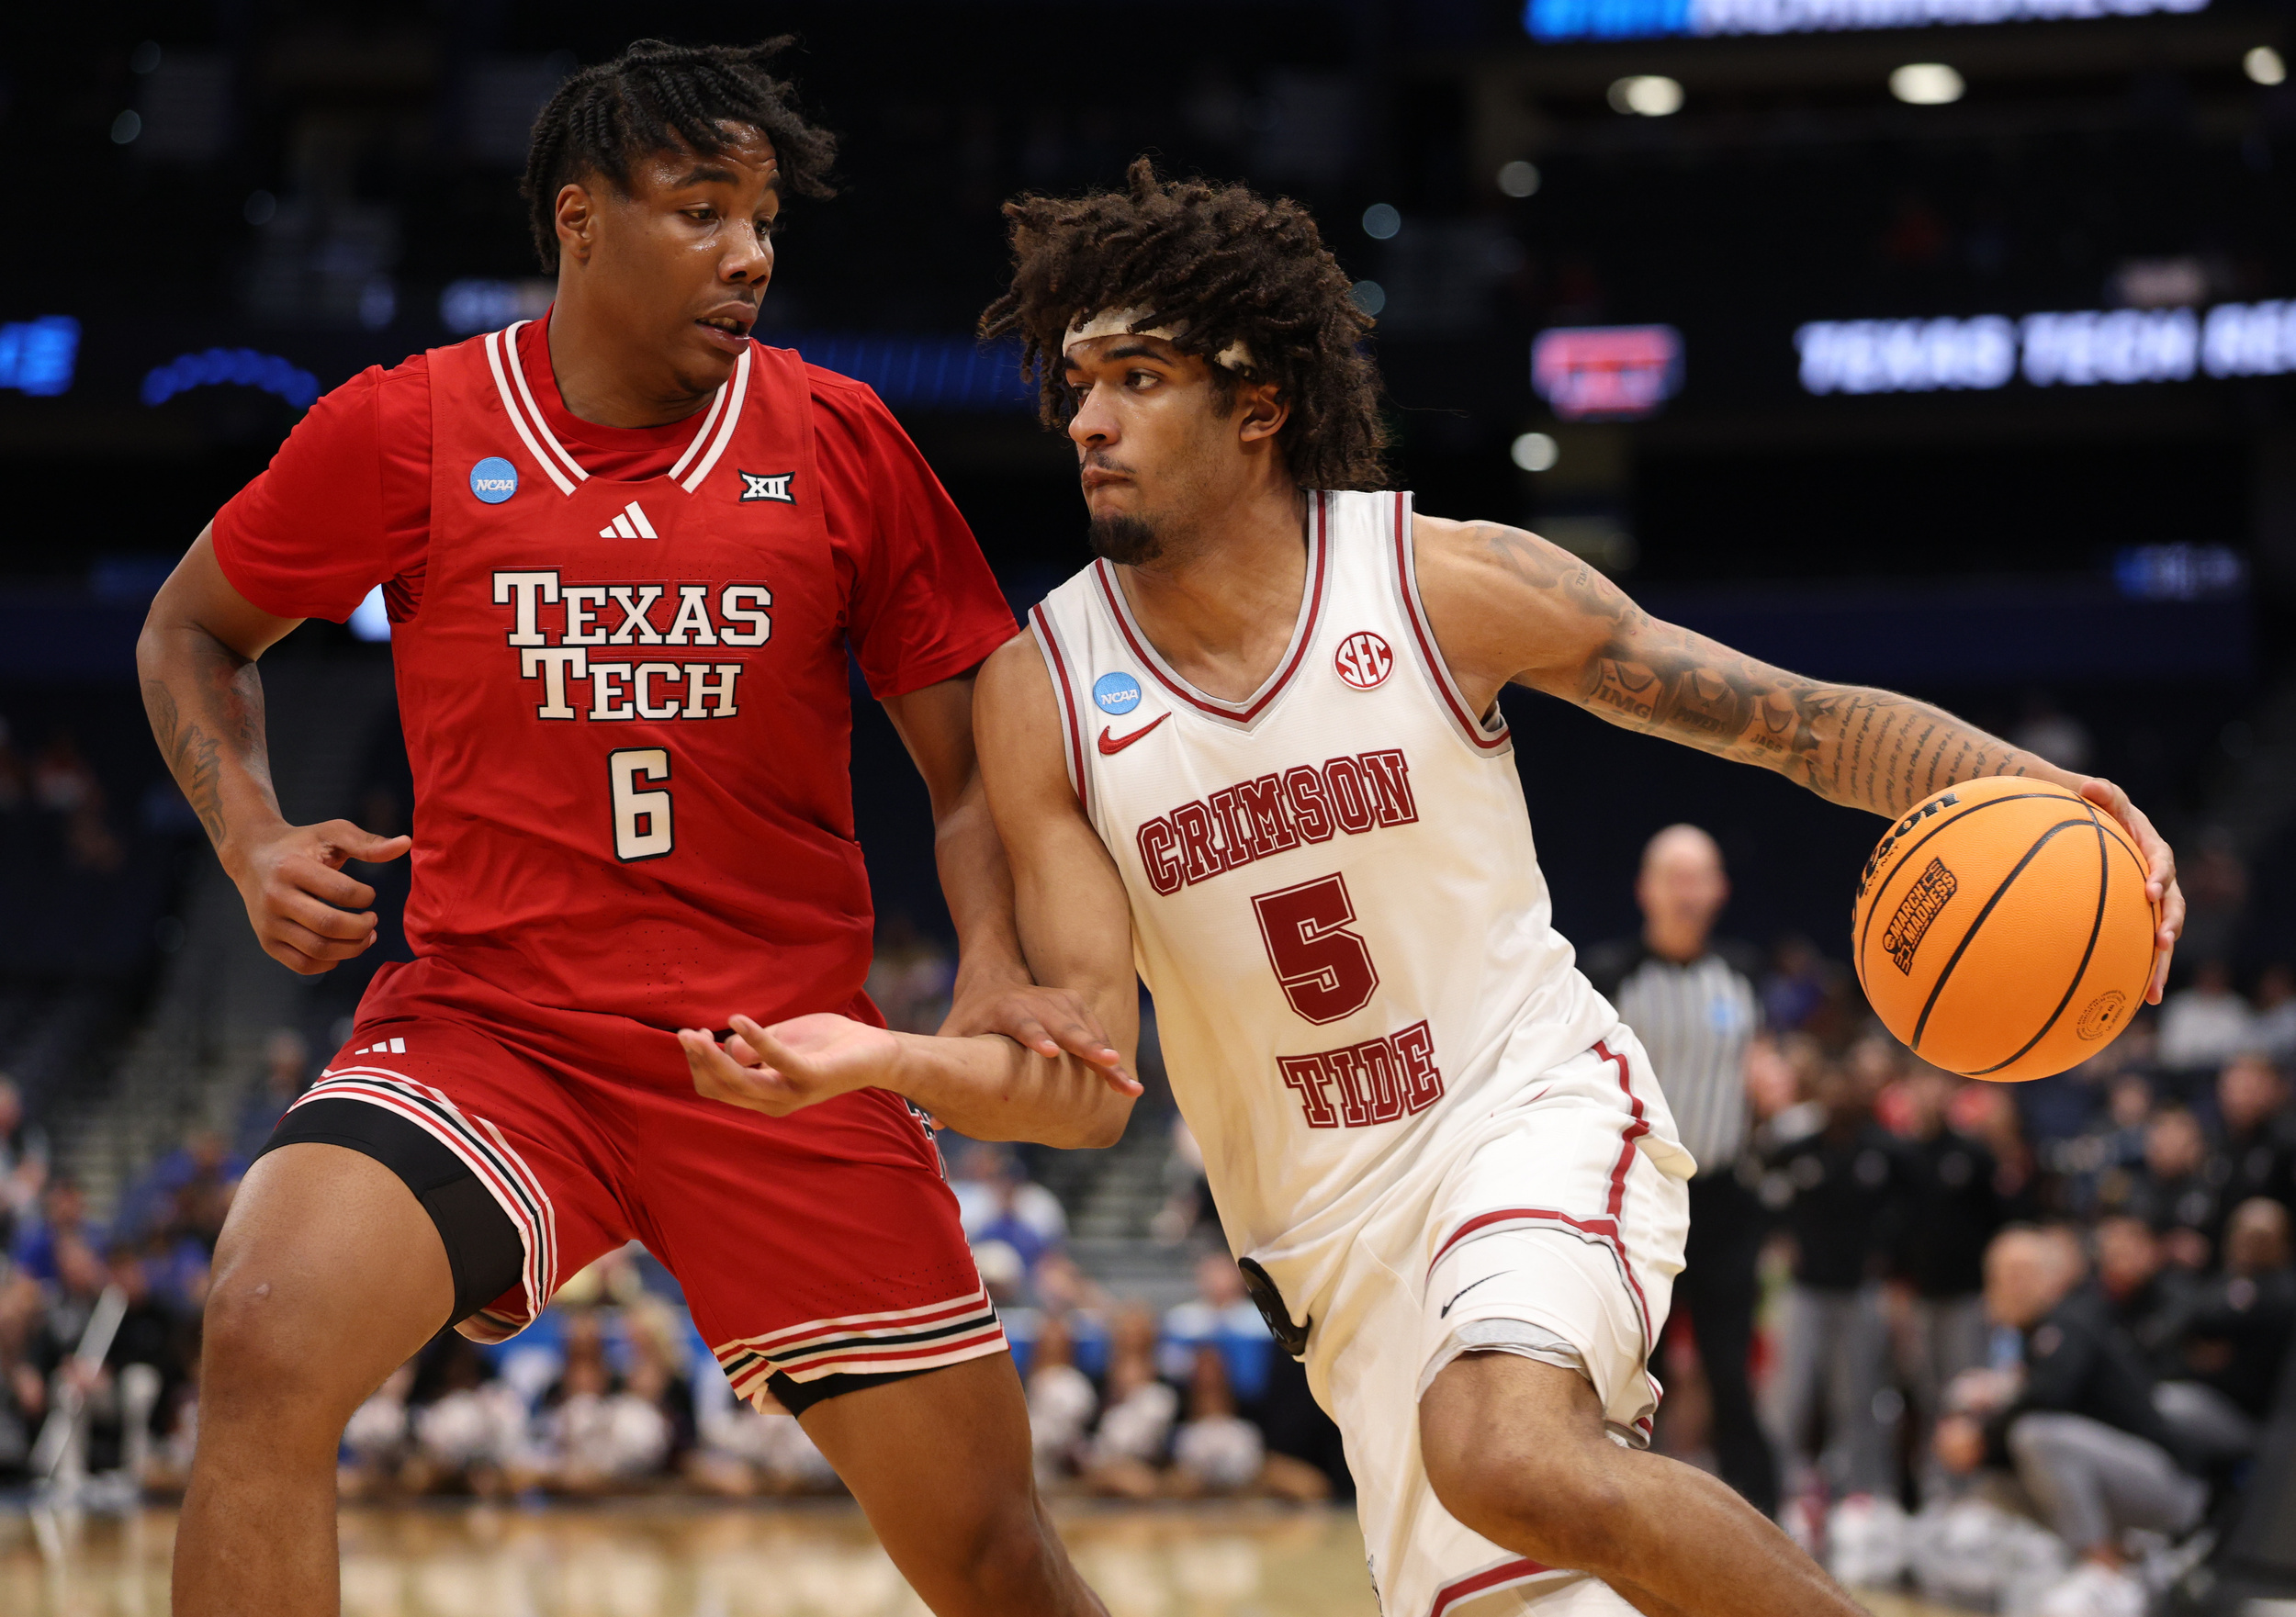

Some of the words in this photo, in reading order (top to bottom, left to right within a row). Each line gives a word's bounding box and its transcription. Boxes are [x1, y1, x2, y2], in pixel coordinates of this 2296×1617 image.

[477, 479, 514, 491] NCAA
[740, 472, 793, 502] XII
[1337, 634, 1391, 686] SEC
[1101, 689, 1139, 705] NCAA
[1597, 685, 1652, 719] IMG
[607, 746, 675, 864] 6
[1136, 748, 1420, 896] CRIMSON
[1889, 884, 1927, 939] MARCH
[1905, 871, 1956, 945] MADNESS
[1250, 871, 1379, 1026] 5
[1277, 1019, 1445, 1129] TIDE
